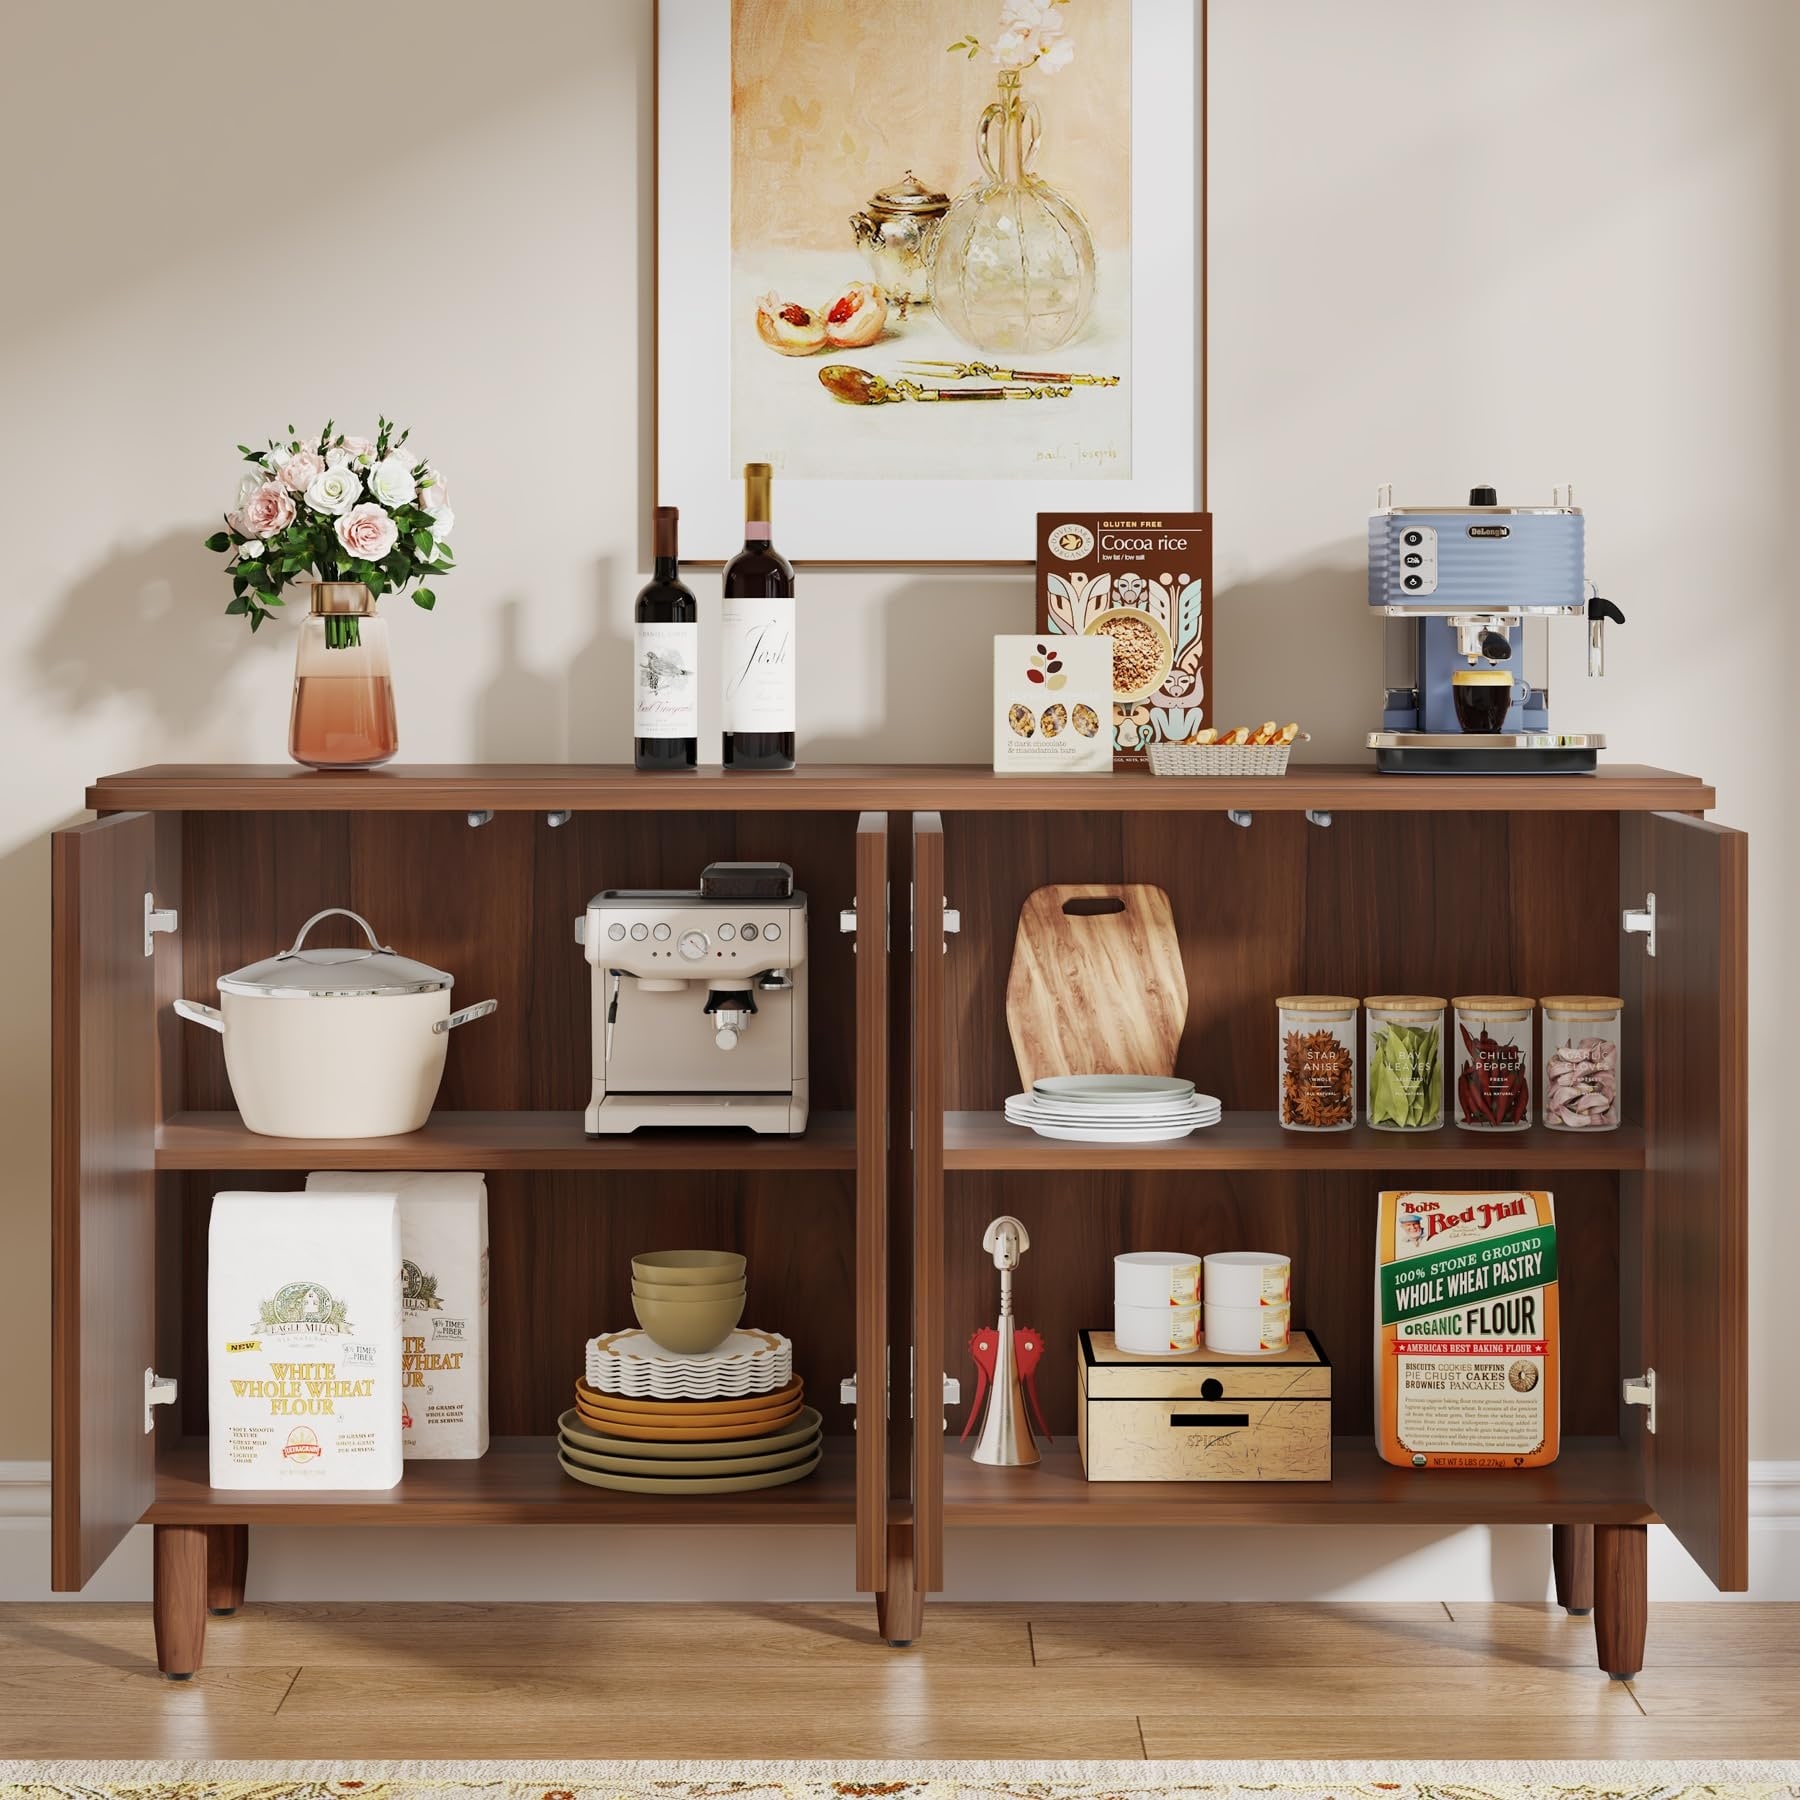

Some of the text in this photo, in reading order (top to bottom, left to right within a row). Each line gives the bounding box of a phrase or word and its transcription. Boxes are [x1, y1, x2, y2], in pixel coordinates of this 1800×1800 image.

[1101, 534, 1188, 551] Cocoa rice
[1307, 1051, 1336, 1060] STAR
[1399, 1051, 1421, 1060] BAY
[1479, 1051, 1518, 1060] CHILLI
[1303, 1062, 1339, 1071] ANISE
[1388, 1062, 1431, 1071] LEAVES
[1475, 1062, 1521, 1071] PEPPER
[1401, 1201, 1440, 1214] Bob's
[1426, 1198, 1527, 1241] Red Mill
[1395, 1237, 1541, 1285] 100% STONE GROUND
[1395, 1251, 1543, 1312] WHOLE WHEAT PASTRY
[403, 1299, 426, 1309] ILLS
[1404, 1295, 1536, 1336] ORGANIC FLOUR
[271, 1322, 300, 1335] EAGLE
[445, 1320, 465, 1329] TIMES
[442, 1327, 463, 1336] FIBER
[230, 1342, 255, 1352] NEW
[356, 1345, 377, 1354] TIMES
[1406, 1343, 1532, 1353] AMERICA'S BEST BAKING FLOUR
[353, 1353, 374, 1362] FIBER
[402, 1352, 464, 1371] WHEAT
[270, 1362, 336, 1381] WHITE
[1405, 1363, 1436, 1371] BISCUITS
[1474, 1364, 1505, 1372] MUFFINS
[1405, 1372, 1505, 1381] PIE CRUST CAKES
[230, 1379, 375, 1398] WHOLE WHEAT
[1405, 1381, 1505, 1390] BROWNIES PANCAKES
[270, 1398, 335, 1416] FLOUR
[1458, 1458, 1463, 1466] 5
[1464, 1458, 1478, 1466] LBS
[1478, 1458, 1506, 1467] (2.27kg)
